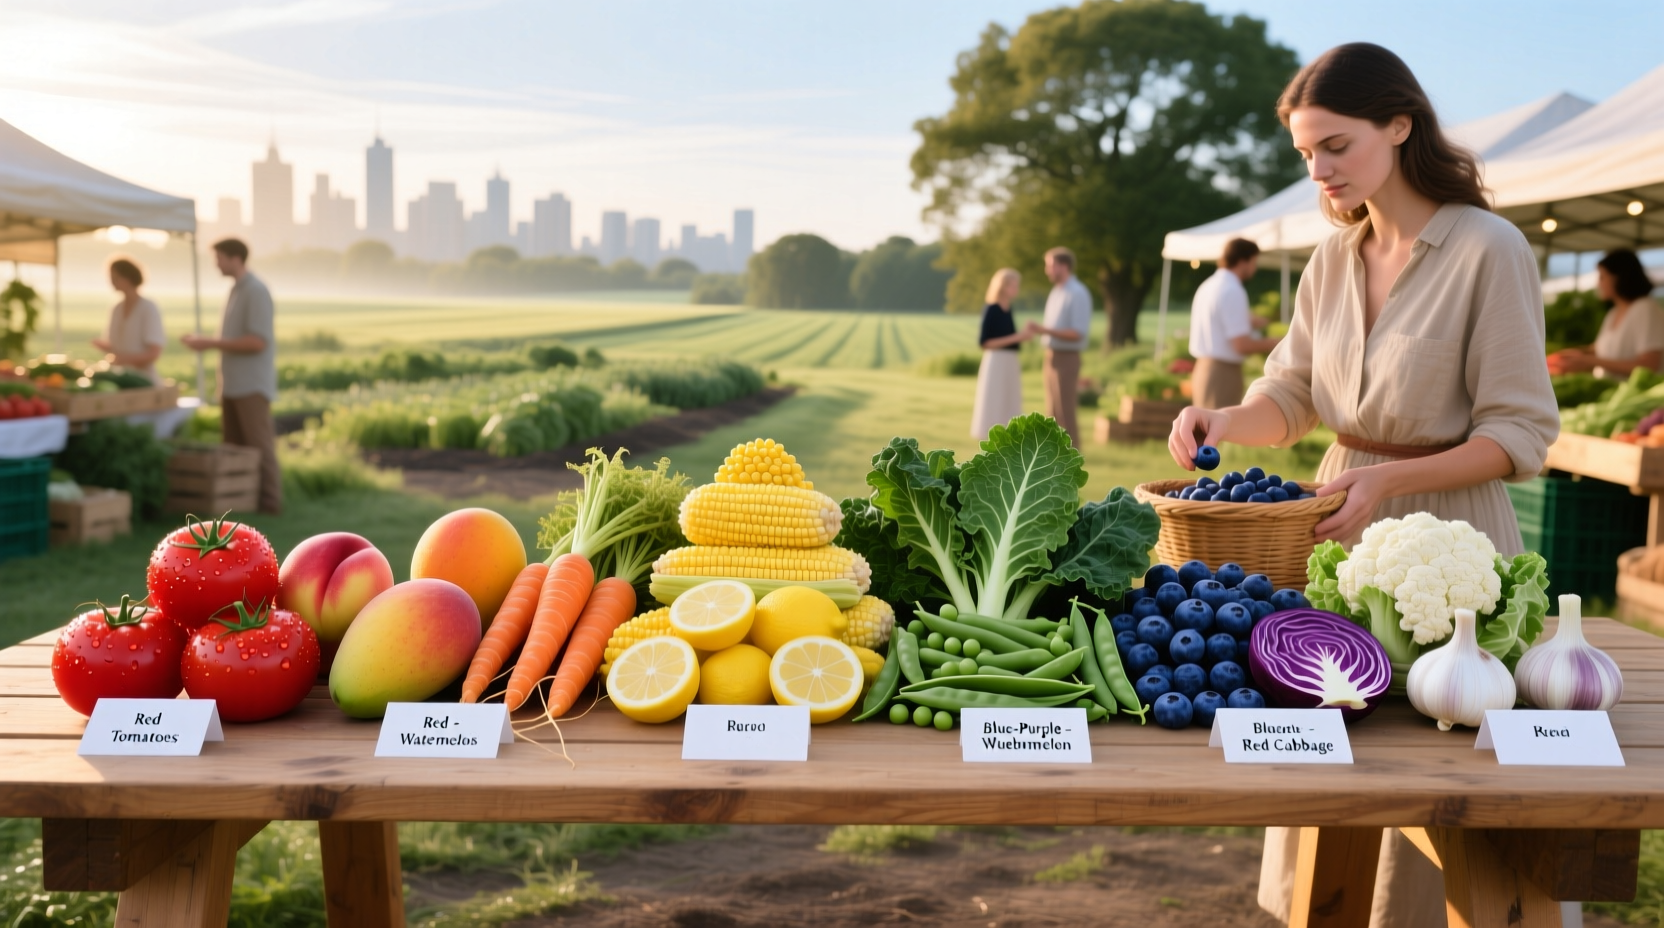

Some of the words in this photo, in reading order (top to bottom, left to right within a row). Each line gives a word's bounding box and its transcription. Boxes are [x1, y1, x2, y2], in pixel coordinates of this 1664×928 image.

[134, 712, 163, 726] Red
[423, 715, 450, 729] Red
[111, 729, 179, 744] Tomatoes
[1242, 738, 1270, 752] Red
